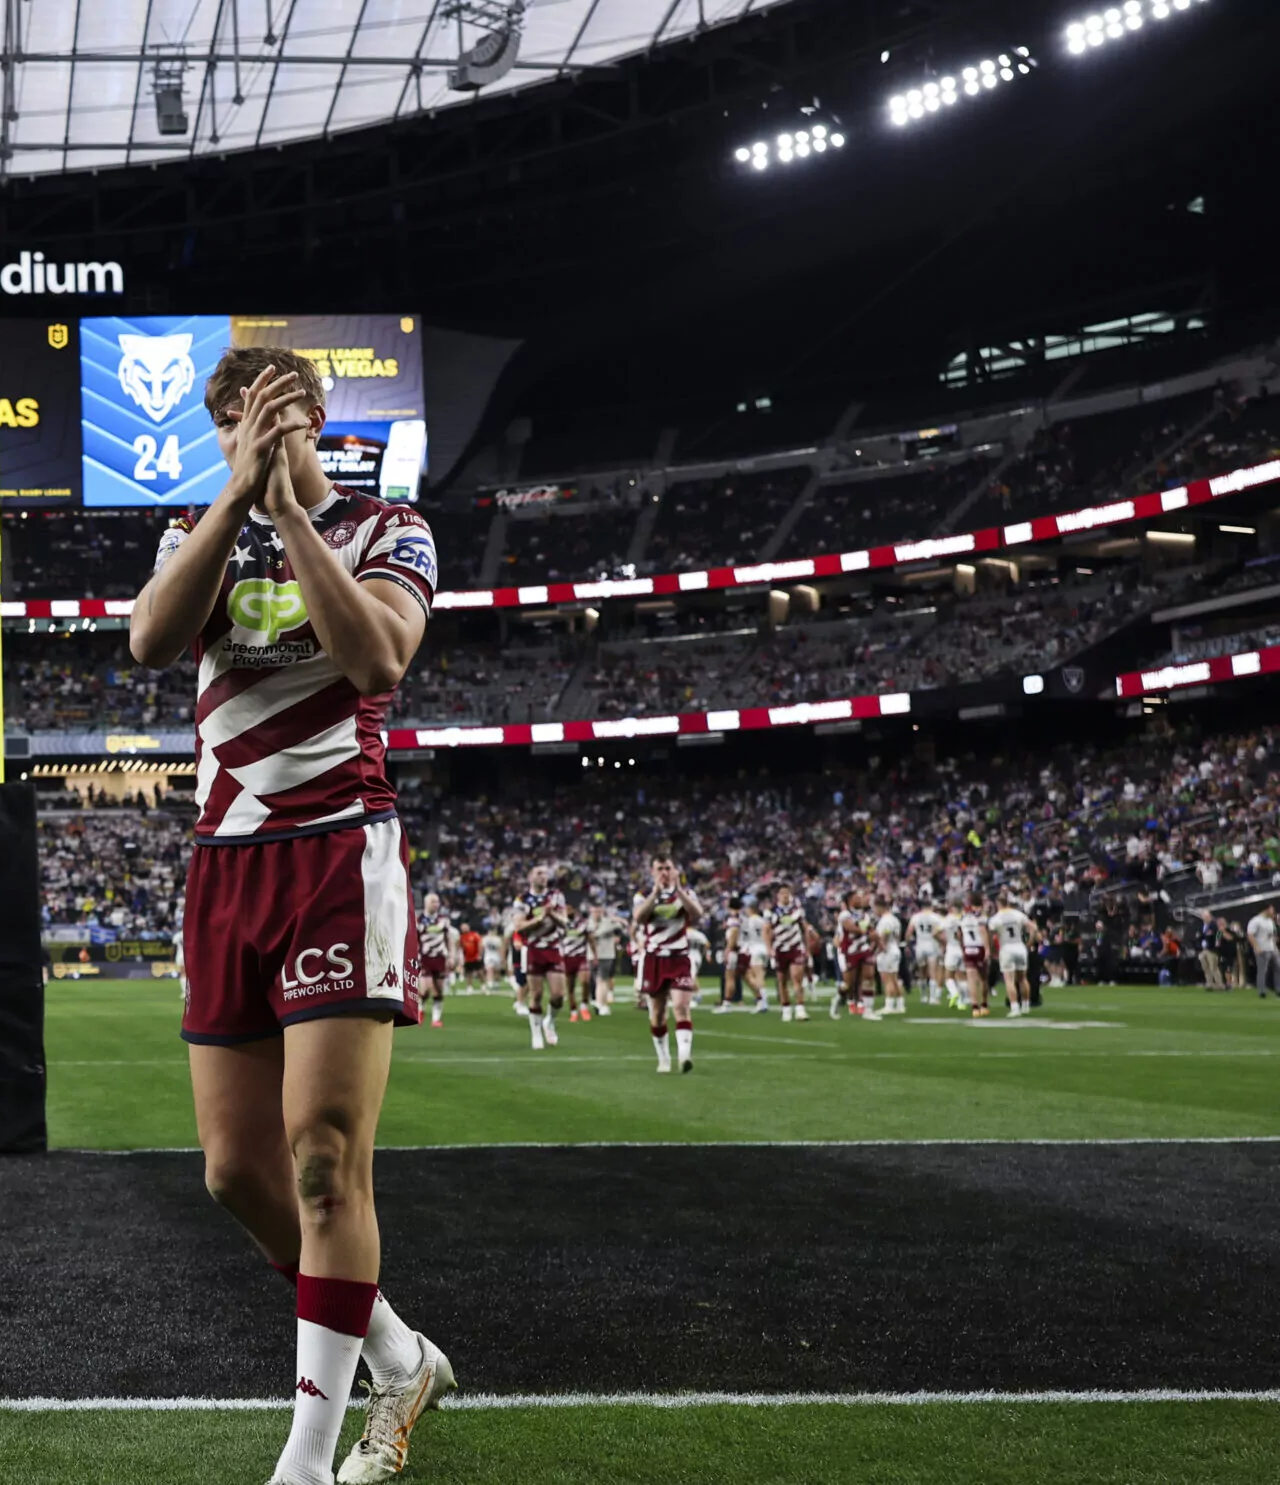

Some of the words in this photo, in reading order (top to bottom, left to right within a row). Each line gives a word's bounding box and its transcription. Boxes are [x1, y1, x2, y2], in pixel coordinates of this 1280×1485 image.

[331, 359, 399, 377] VEGAS
[133, 434, 183, 481] 24
[233, 653, 294, 668] Projects
[281, 942, 353, 990] LCS
[283, 982, 331, 1002] PIPEWORK
[333, 979, 354, 991] LTD
